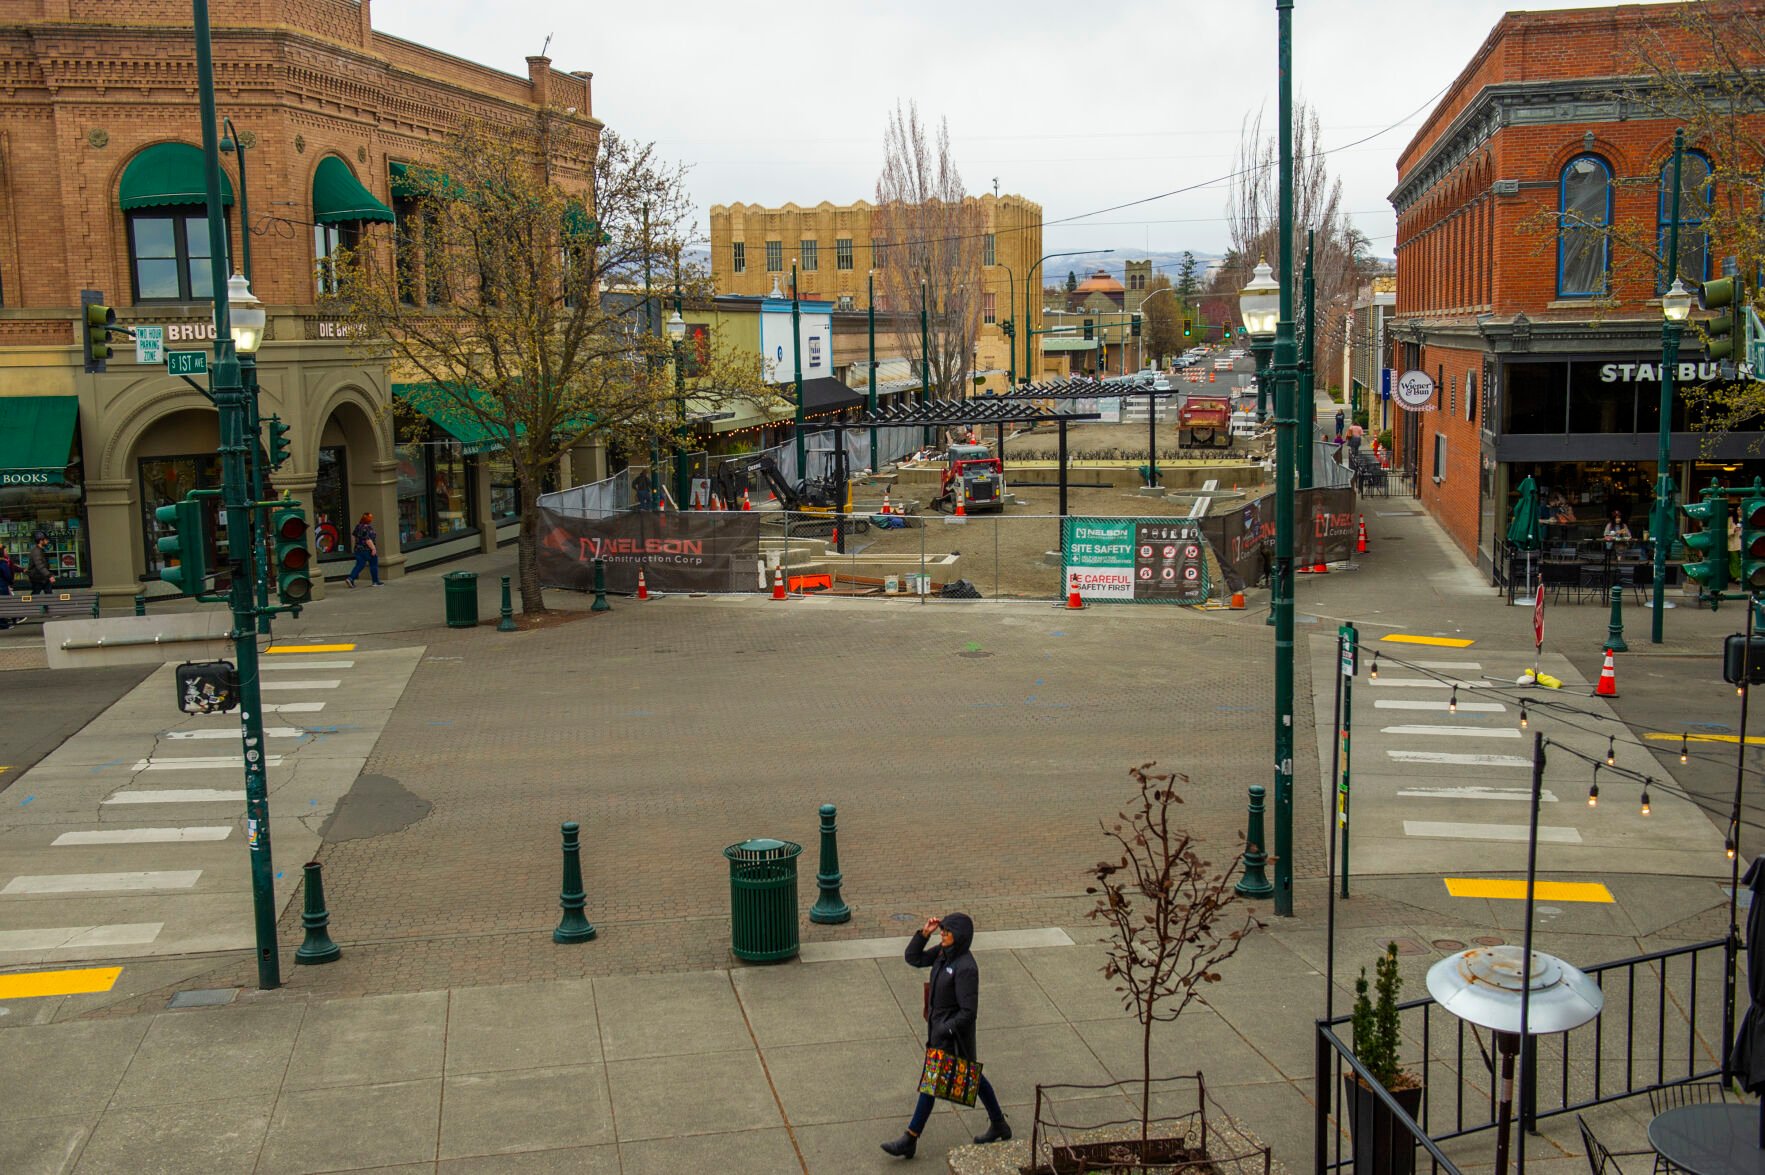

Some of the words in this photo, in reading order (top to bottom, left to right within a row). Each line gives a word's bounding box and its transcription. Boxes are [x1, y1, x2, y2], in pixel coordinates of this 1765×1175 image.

[137, 328, 147, 339] TWO
[148, 328, 162, 338] HOUR
[168, 322, 217, 340] BRÜC
[320, 323, 334, 337] DIE
[140, 340, 160, 350] PARKING
[144, 351, 157, 361] ZONE
[171, 358, 176, 369] S
[179, 355, 192, 371] 1ST
[194, 358, 204, 368] AVE
[1601, 362, 1755, 382] STABUK
[1401, 379, 1431, 390] Wiener
[1413, 388, 1429, 396] Bun
[3, 473, 48, 484] BOOKS
[601, 538, 703, 555] NELSON
[1071, 543, 1092, 553] SITE
[1094, 545, 1132, 554] SAFETY
[601, 554, 671, 563] Construction
[674, 555, 703, 565] Corp
[1084, 574, 1131, 584] CAREFUL
